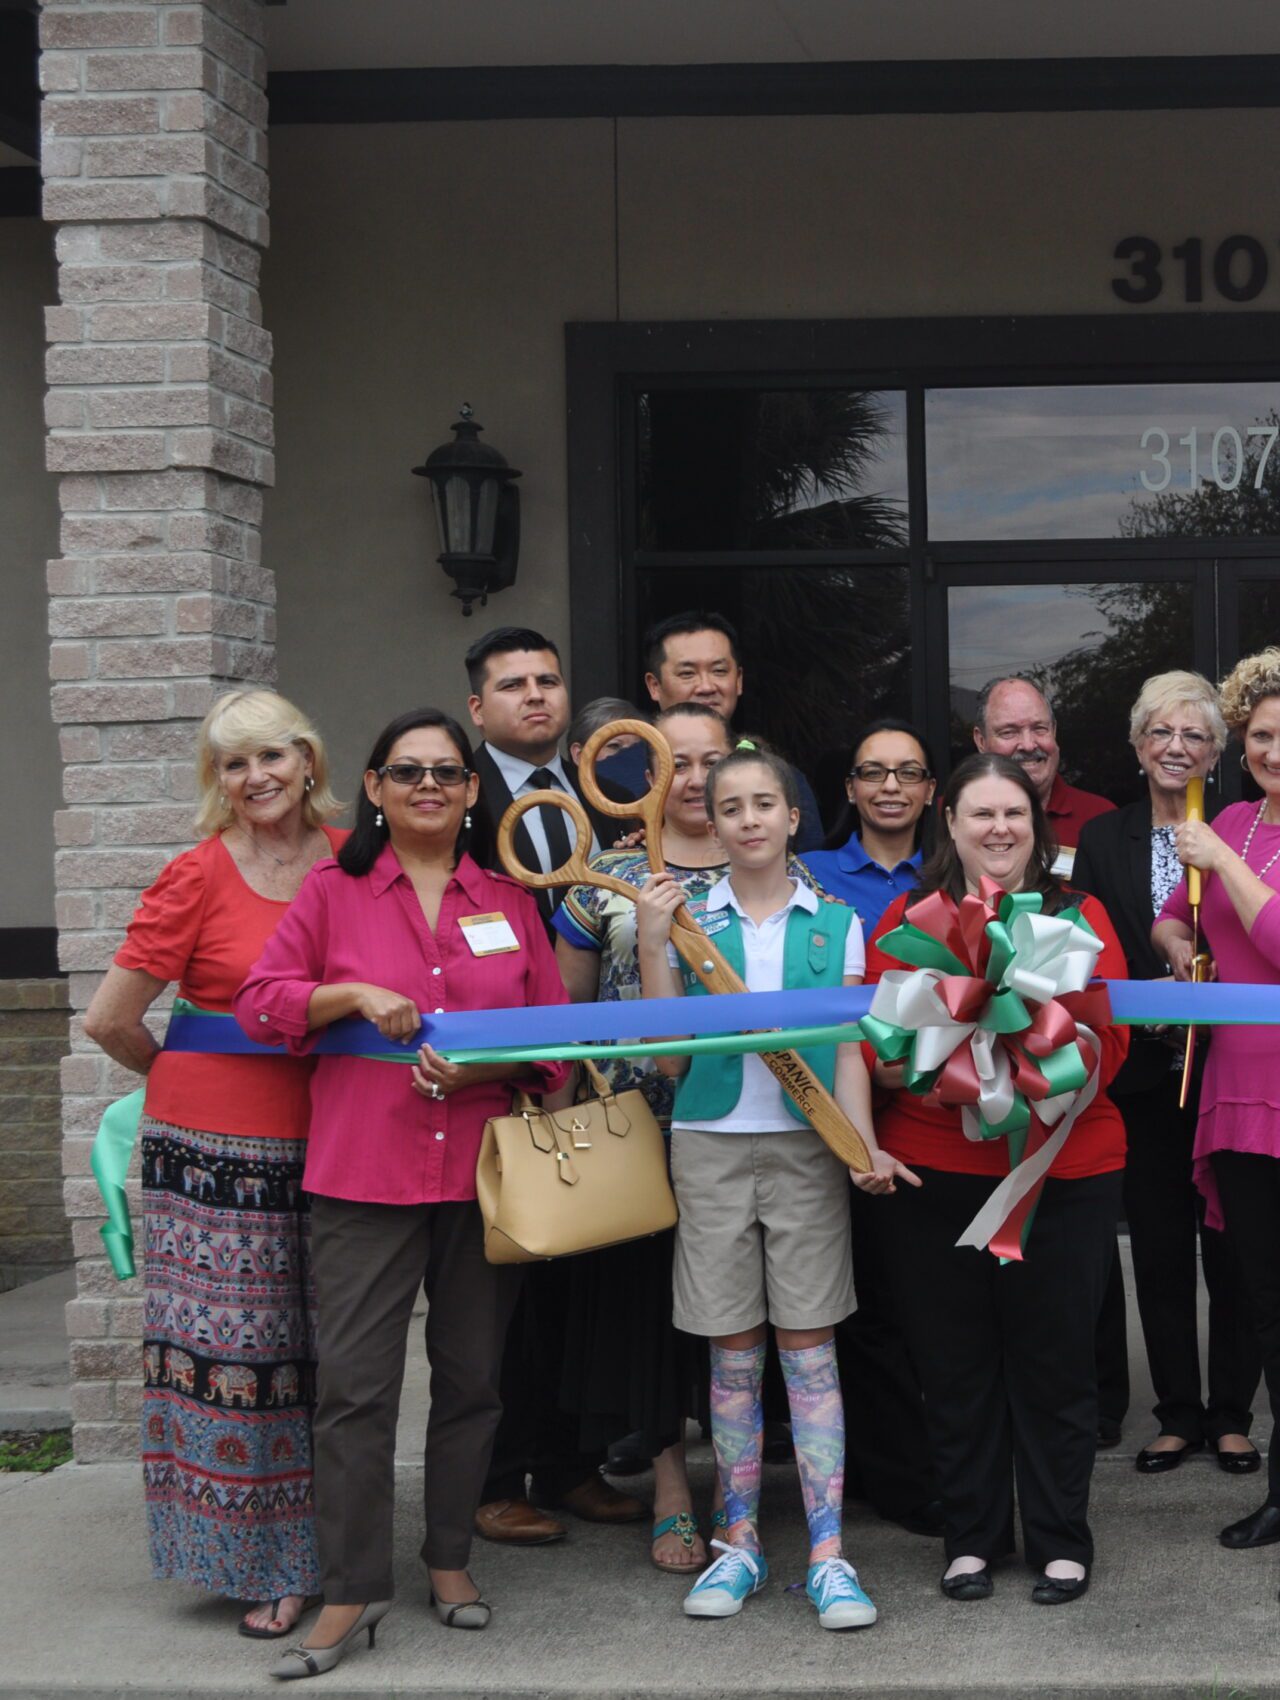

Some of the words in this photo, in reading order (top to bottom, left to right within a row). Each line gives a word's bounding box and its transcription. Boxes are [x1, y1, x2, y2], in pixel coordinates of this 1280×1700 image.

[1139, 425, 1279, 492] 3107
[769, 1060, 815, 1117] COMMERCE
[771, 1050, 819, 1098] PANIC
